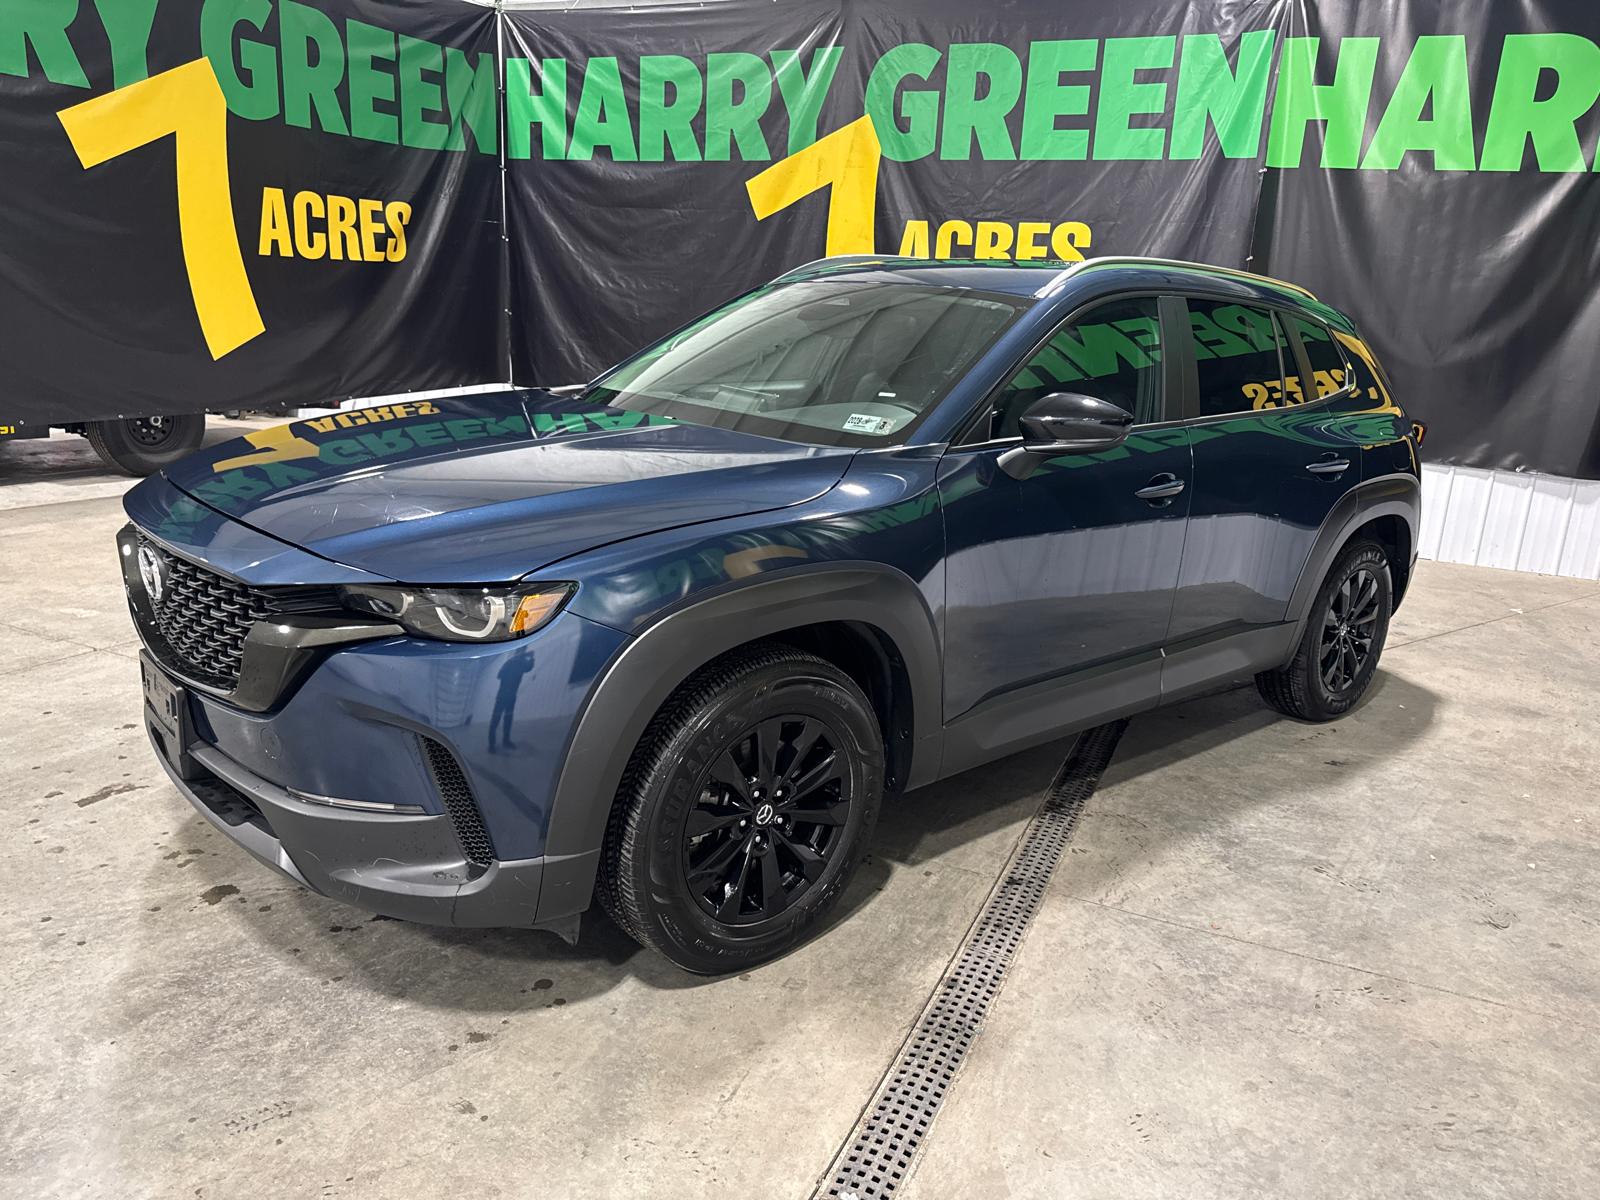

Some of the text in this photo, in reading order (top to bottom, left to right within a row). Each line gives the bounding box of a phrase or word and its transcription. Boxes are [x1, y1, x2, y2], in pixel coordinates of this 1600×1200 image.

[200, 0, 497, 155] GREEN
[506, 30, 1275, 162] HARRY GREEN
[1266, 33, 1600, 173] HAR
[56, 56, 412, 361] 7 ACRES
